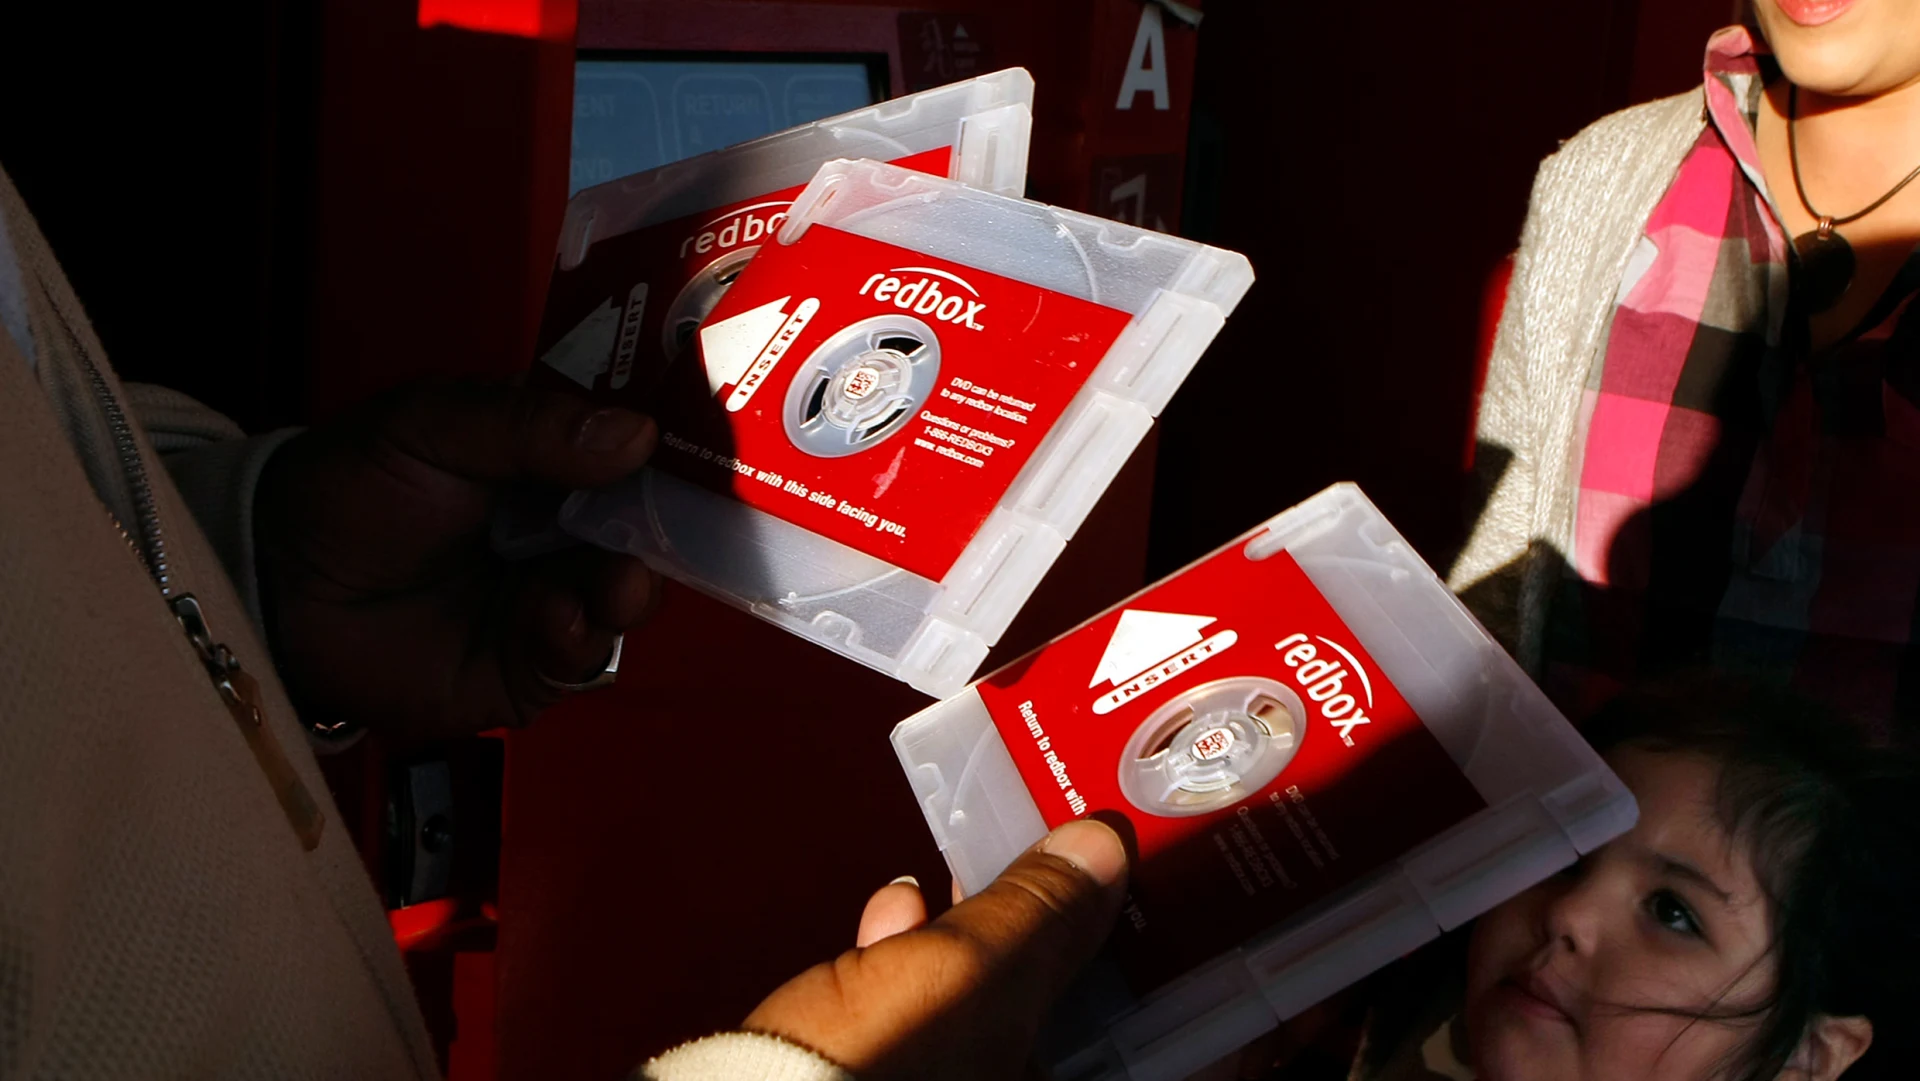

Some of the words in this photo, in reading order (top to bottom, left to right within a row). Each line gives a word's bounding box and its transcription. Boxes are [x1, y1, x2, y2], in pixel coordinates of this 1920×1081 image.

[1115, 3, 1170, 110] A
[576, 94, 616, 117] ENT
[680, 212, 787, 259] redbo
[859, 273, 986, 328] redbox
[616, 299, 642, 375] INSERT
[739, 314, 803, 396] INSERT
[950, 377, 973, 391] DVD
[662, 431, 700, 455] Return
[699, 447, 713, 461] to
[713, 451, 757, 478] redbox
[755, 469, 784, 489] with
[782, 479, 809, 498] this
[808, 489, 836, 510] side
[836, 499, 879, 528] facing
[876, 518, 907, 538] you.
[1112, 642, 1213, 703] INSERT
[1274, 633, 1371, 739] redbox
[1018, 700, 1044, 739] Return
[1036, 736, 1051, 751] to
[1043, 750, 1072, 790] redbox
[1065, 788, 1087, 816] with
